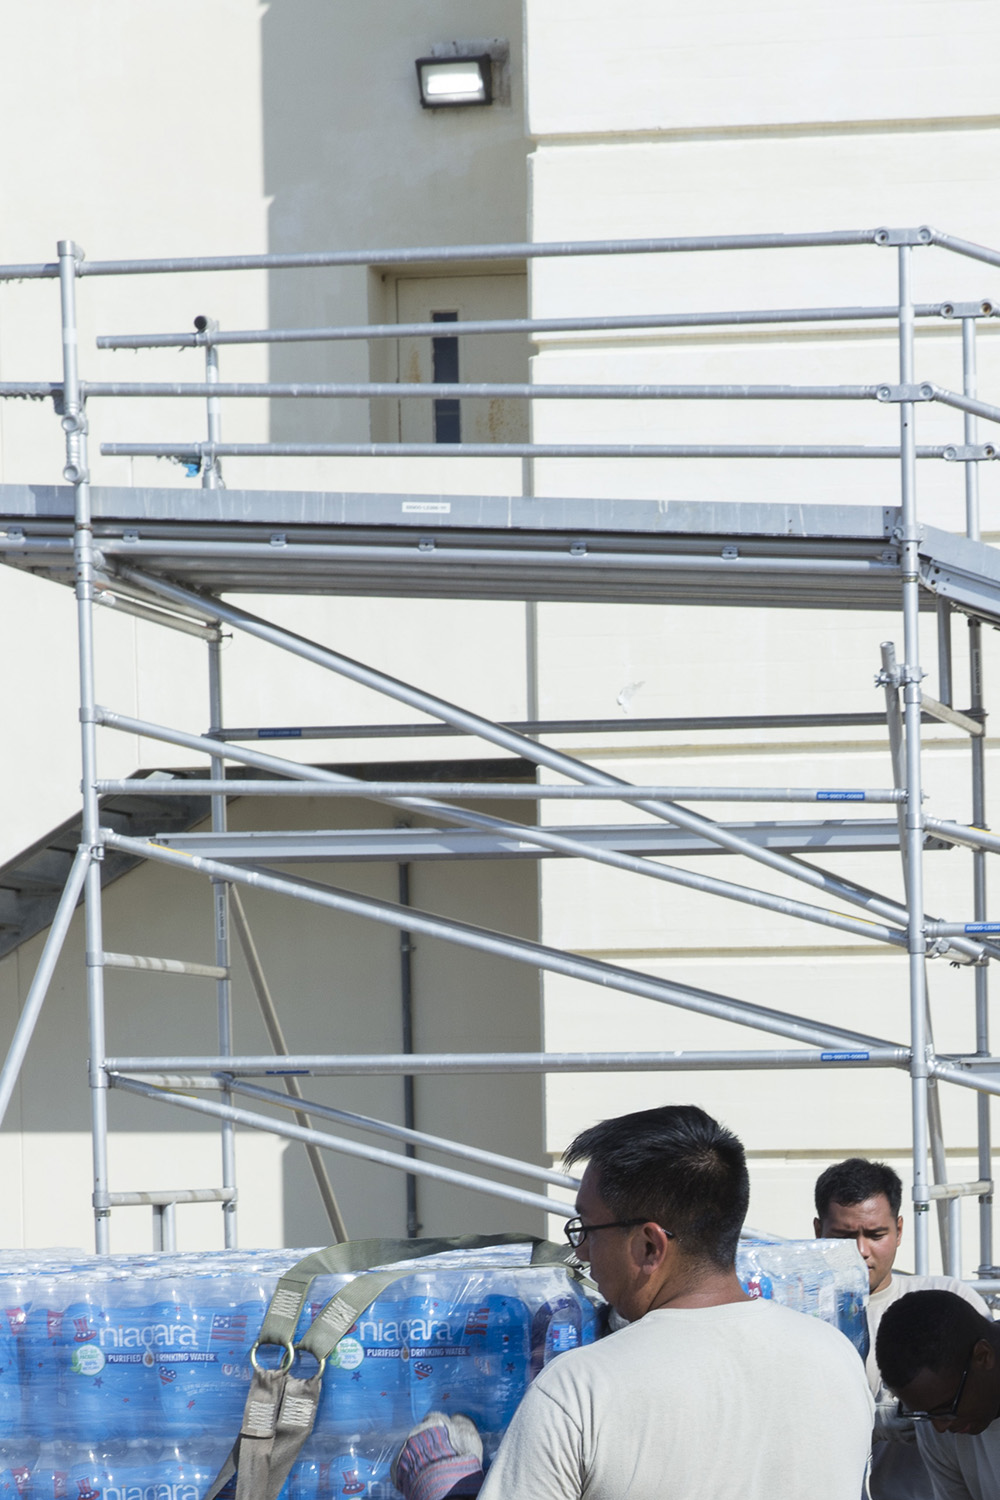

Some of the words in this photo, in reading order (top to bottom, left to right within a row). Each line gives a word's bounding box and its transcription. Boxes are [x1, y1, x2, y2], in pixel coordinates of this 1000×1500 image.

[100, 1324, 199, 1350] niagara
[360, 1319, 452, 1345] niagara
[108, 1354, 141, 1362] PURIFIED
[157, 1353, 188, 1362] DRINKING
[190, 1353, 215, 1361] WATER
[367, 1349, 400, 1357] PURIFIED
[411, 1349, 443, 1357] DRINKING
